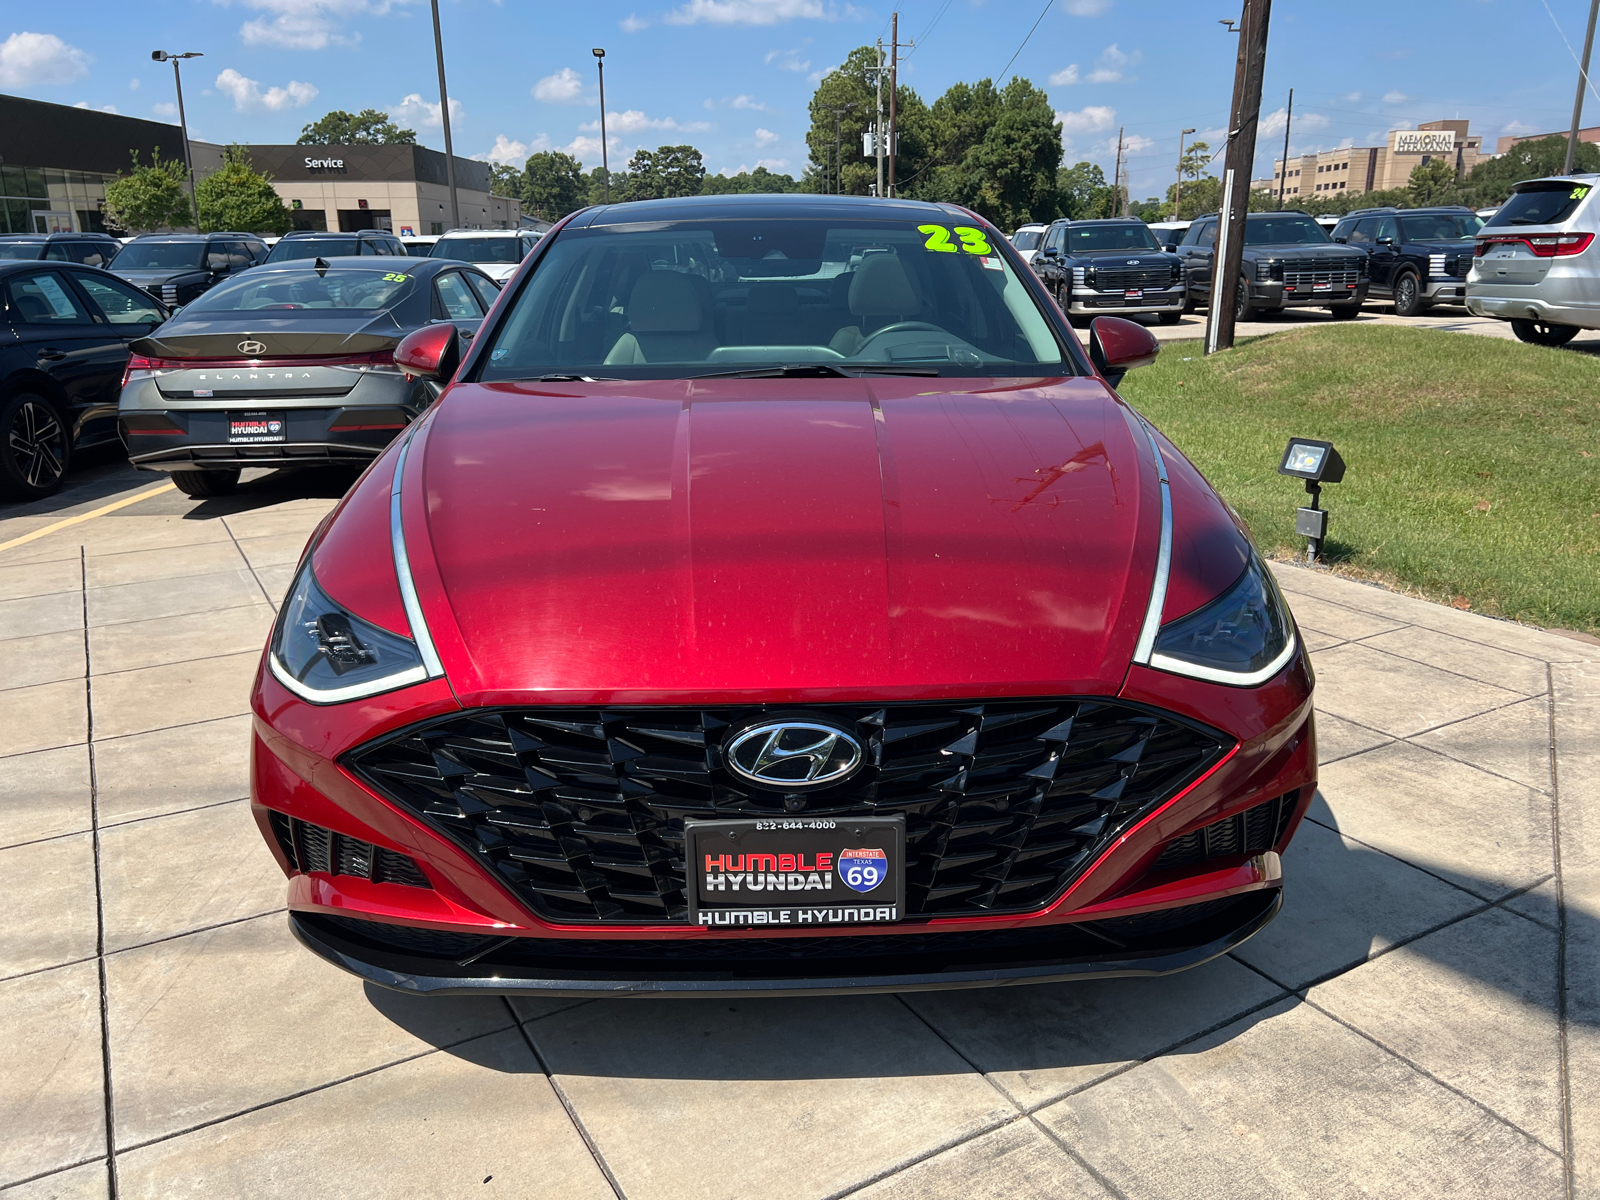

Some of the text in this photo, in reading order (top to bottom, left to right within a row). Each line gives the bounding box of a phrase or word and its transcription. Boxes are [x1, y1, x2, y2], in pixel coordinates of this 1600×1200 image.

[1399, 133, 1452, 143] MEMORIAL
[1398, 142, 1452, 151] HERMANN
[305, 158, 344, 168] Service
[1569, 187, 1588, 200] 24
[917, 224, 992, 255] 23
[382, 273, 407, 283] 25
[705, 853, 833, 871] HUMBLE
[706, 872, 833, 891] HYUNDAI
[847, 866, 878, 886] 69
[698, 907, 897, 925] HUMBLE HYUNDAI
